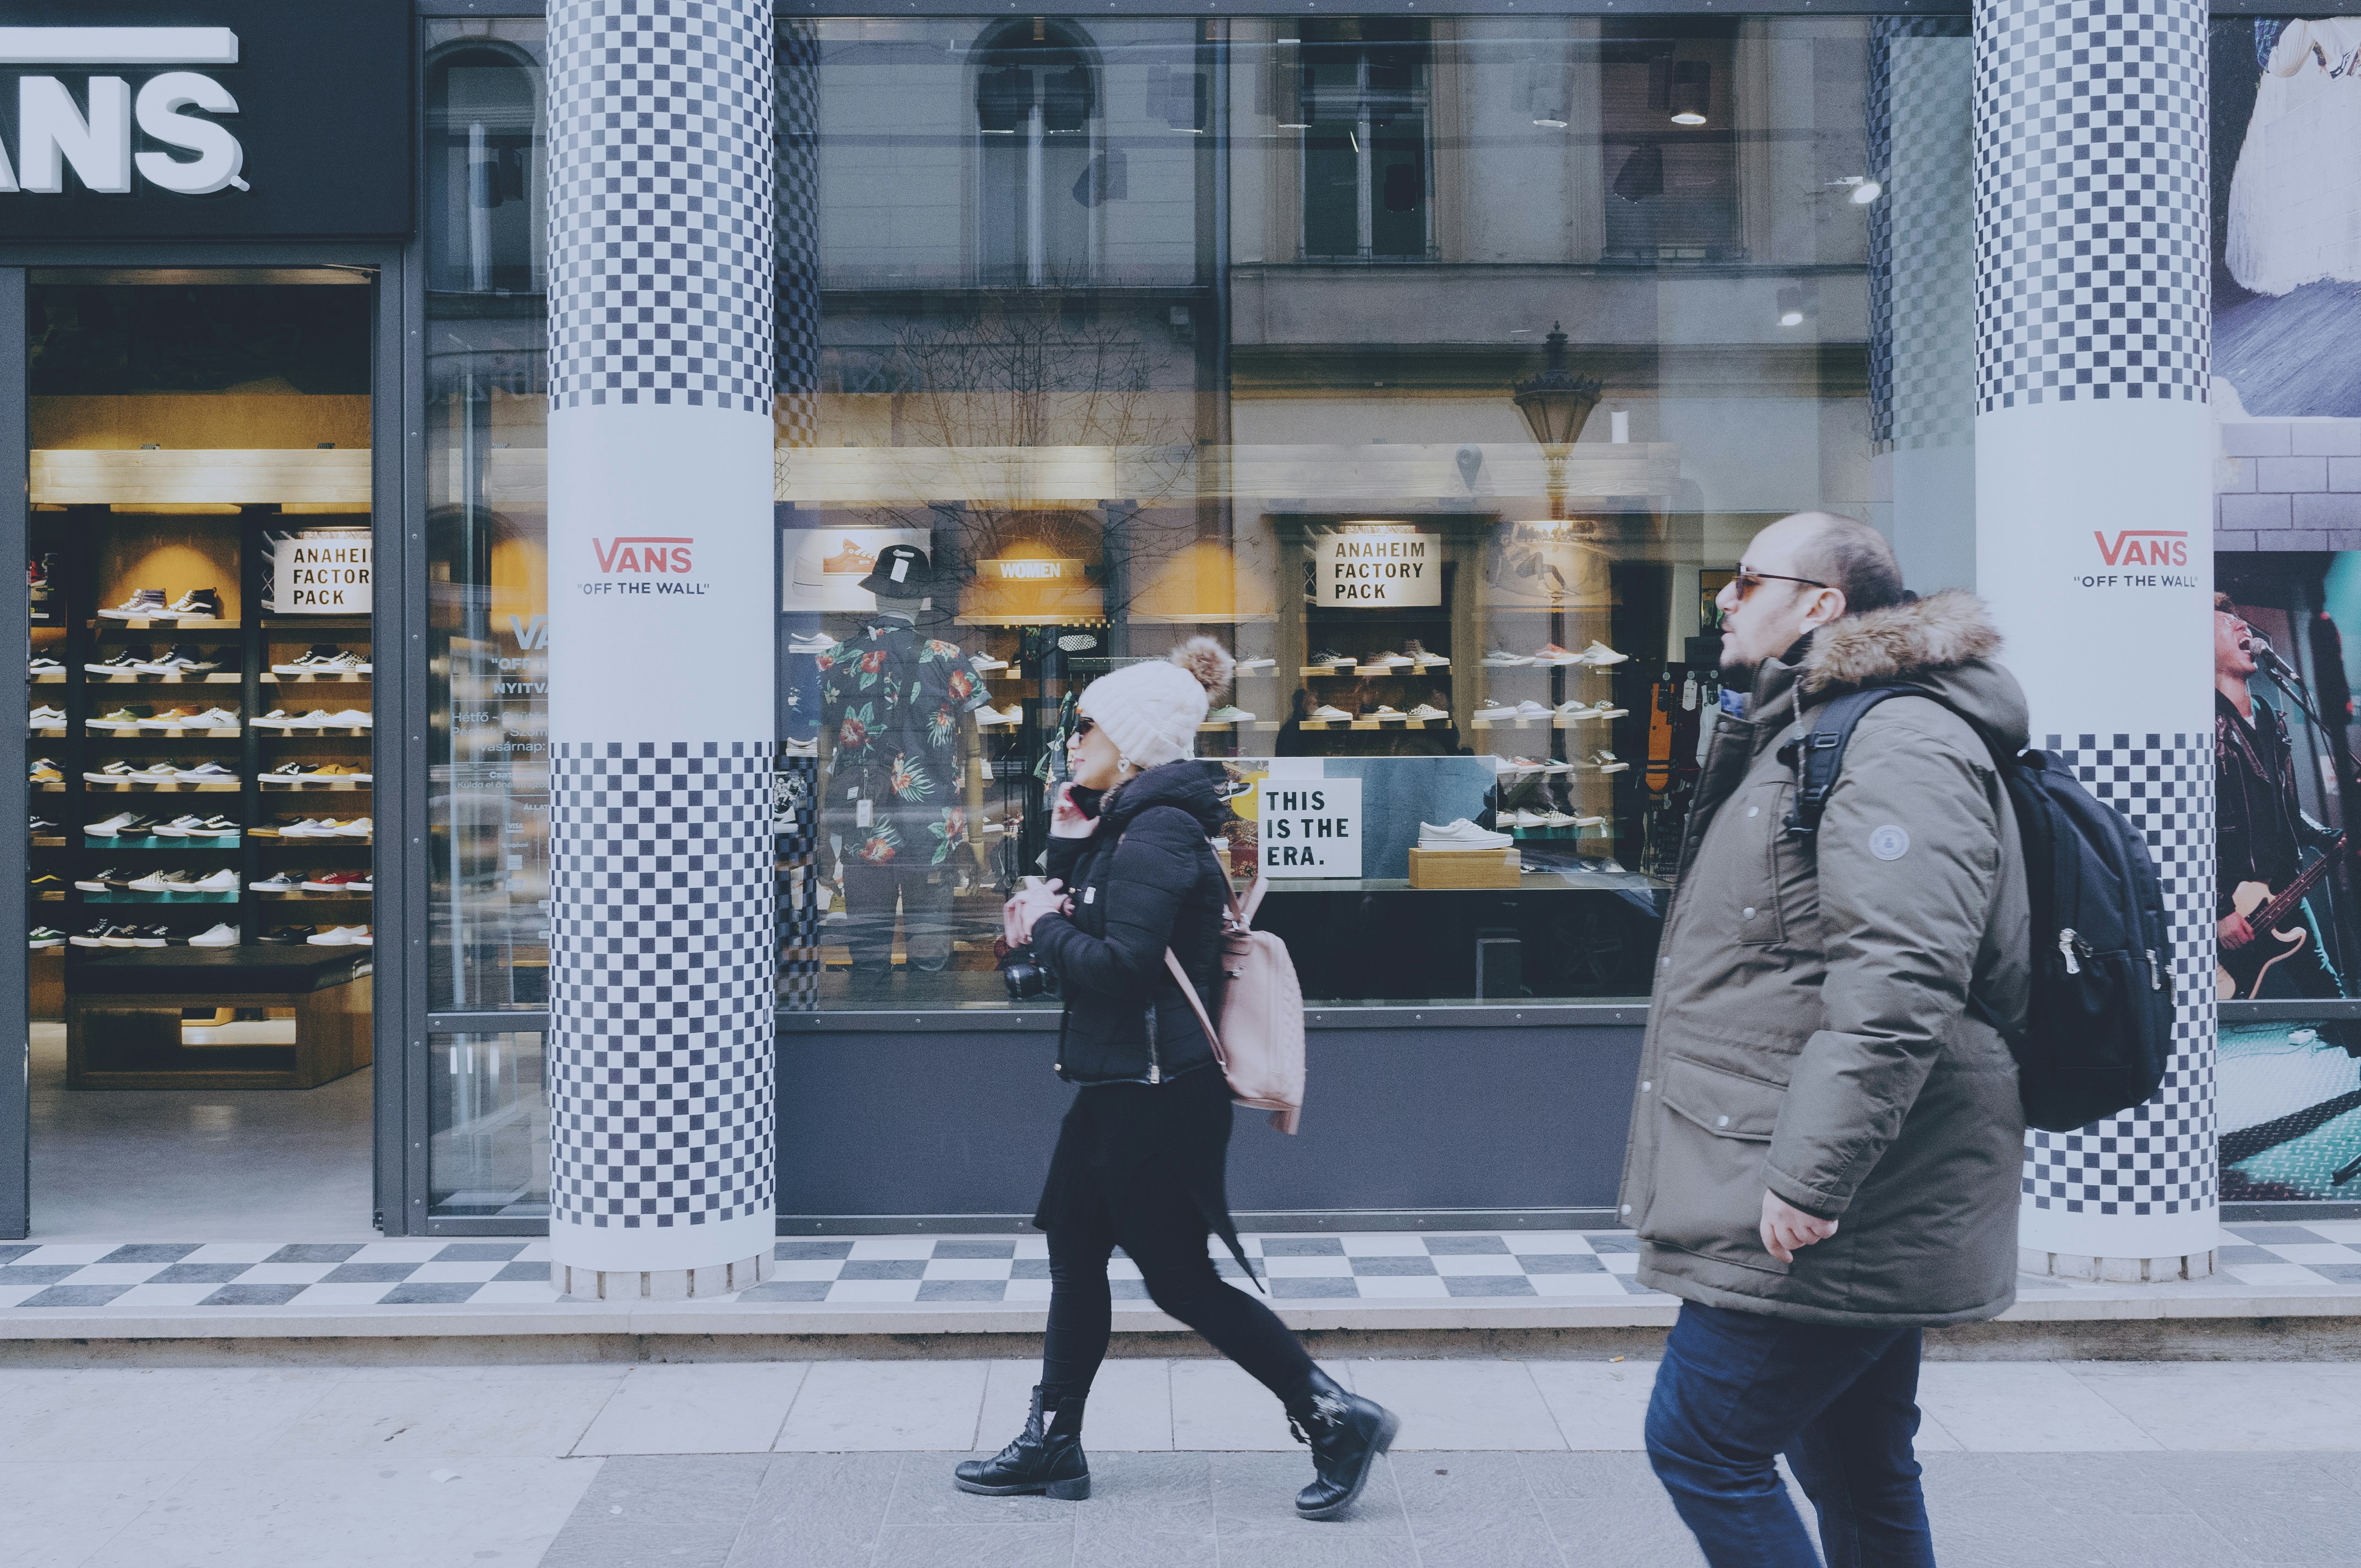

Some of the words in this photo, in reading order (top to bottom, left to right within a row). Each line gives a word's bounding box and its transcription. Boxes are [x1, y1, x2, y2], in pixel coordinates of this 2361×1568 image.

[293, 548, 372, 563] ANAHEI
[592, 537, 693, 573] VANS
[1335, 542, 1425, 558] ANAHEIM
[2093, 530, 2188, 566] VANS
[1000, 563, 1060, 578] WOMEN
[1335, 563, 1423, 579] FACTORY
[578, 583, 612, 595] "OFF
[618, 582, 651, 594] THE
[656, 582, 709, 595] WALL"
[2074, 576, 2118, 587] "OFF
[2124, 575, 2156, 586] THE
[293, 590, 344, 605] PACK
[1335, 584, 1385, 599] PACK
[453, 711, 488, 722] Hétfő
[1266, 791, 1325, 811] THIS
[1267, 819, 1291, 839] IS
[1301, 818, 1348, 838] THE
[1267, 846, 1325, 866] ERA.
